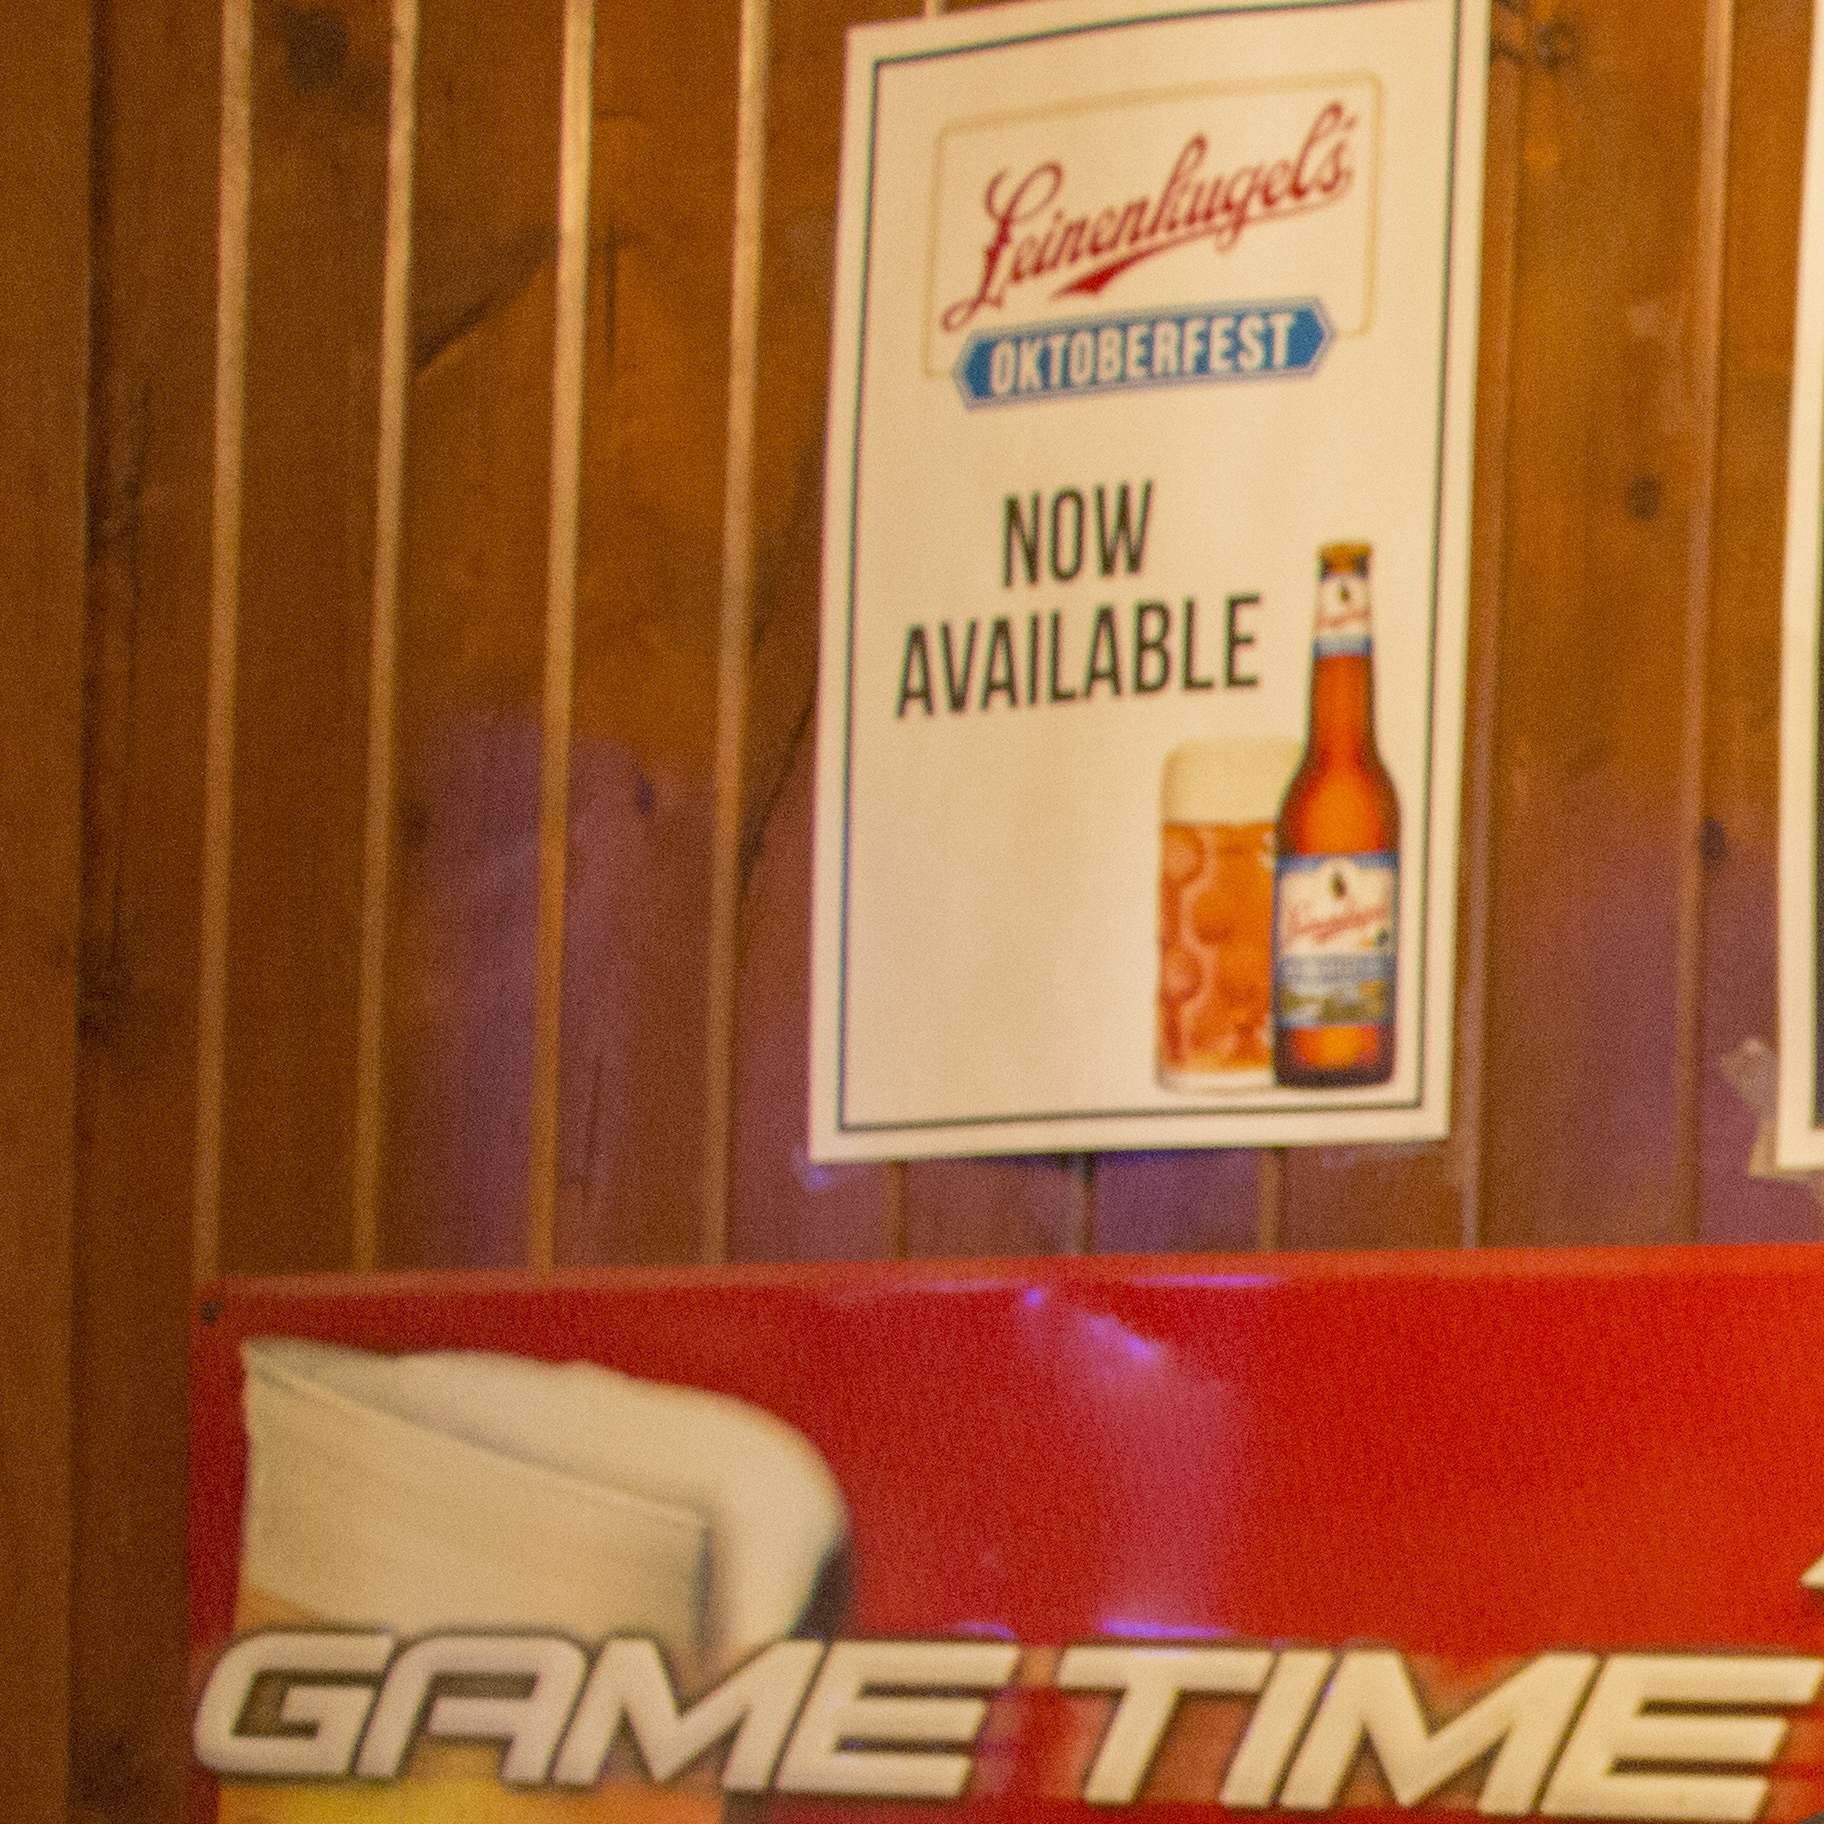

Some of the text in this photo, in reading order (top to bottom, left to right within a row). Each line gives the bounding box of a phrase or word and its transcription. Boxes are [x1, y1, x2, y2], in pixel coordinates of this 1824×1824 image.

[941, 102, 1358, 333] Leinenkugel's
[990, 312, 1297, 396] OKTOBERFEST
[1003, 481, 1153, 588] NOW
[896, 593, 1262, 718] AVAILABLE
[193, 1630, 1021, 1799] GAME
